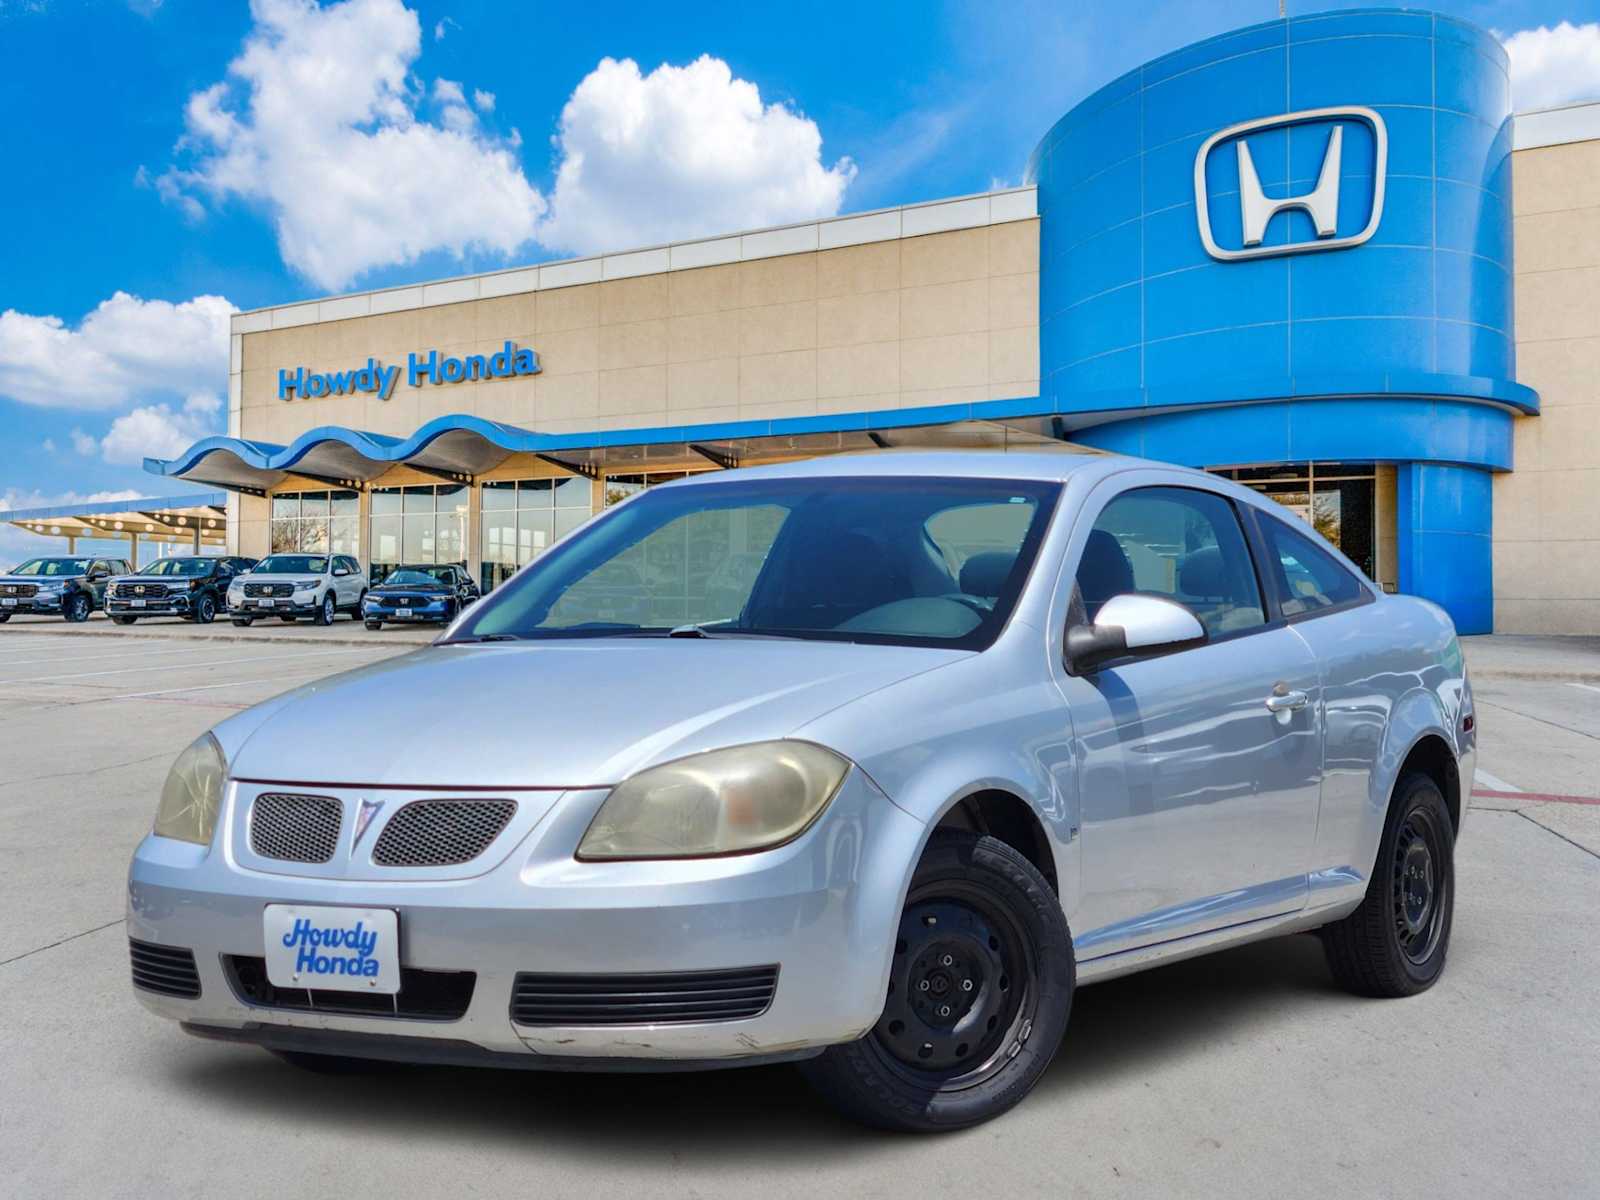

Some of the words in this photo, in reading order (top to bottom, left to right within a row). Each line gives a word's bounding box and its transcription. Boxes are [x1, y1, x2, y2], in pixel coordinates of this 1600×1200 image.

[278, 358, 400, 400] Howdy
[408, 341, 541, 387] Honda
[283, 918, 378, 957] Howdy
[296, 947, 379, 977] Honda
